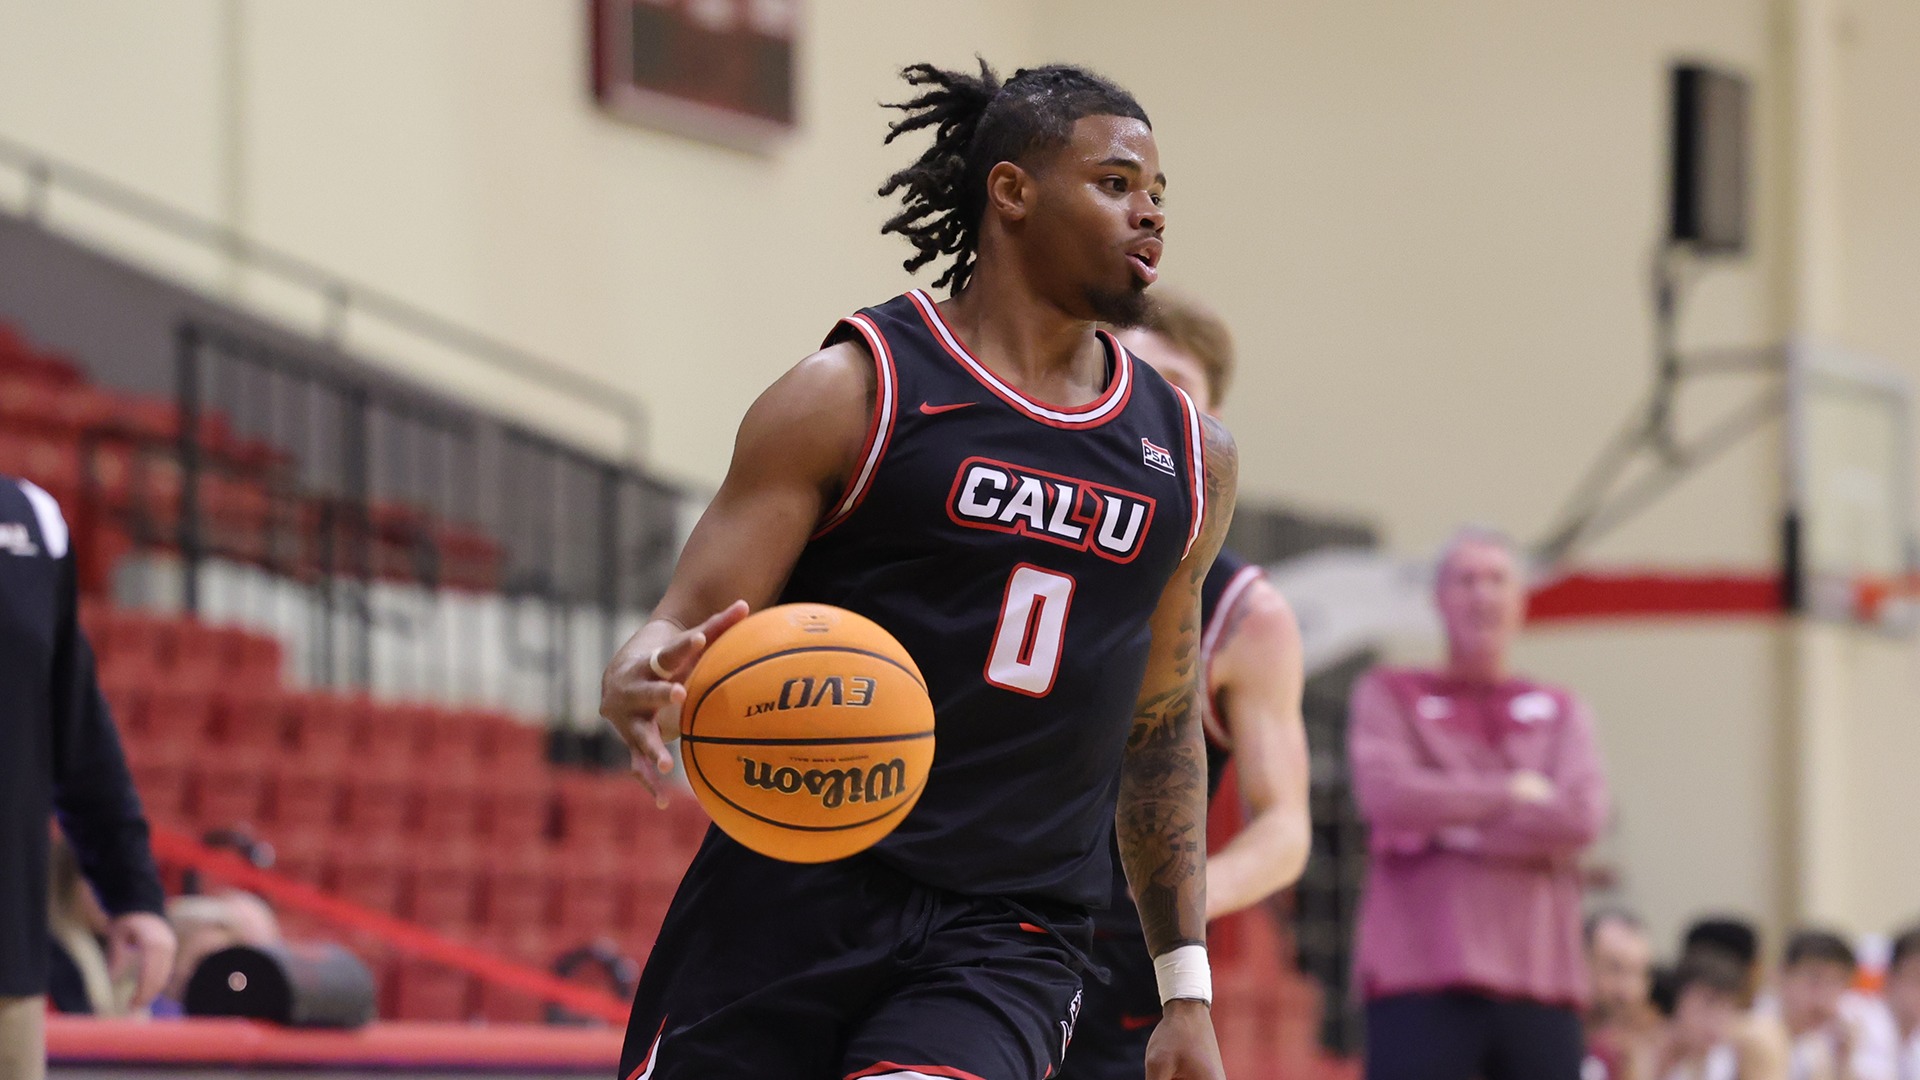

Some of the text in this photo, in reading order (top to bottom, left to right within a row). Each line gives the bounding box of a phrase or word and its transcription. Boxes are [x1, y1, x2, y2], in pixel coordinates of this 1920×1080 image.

[985, 564, 1075, 697] 0
[744, 676, 876, 718] EVO NXT
[742, 756, 907, 809] Wilson
